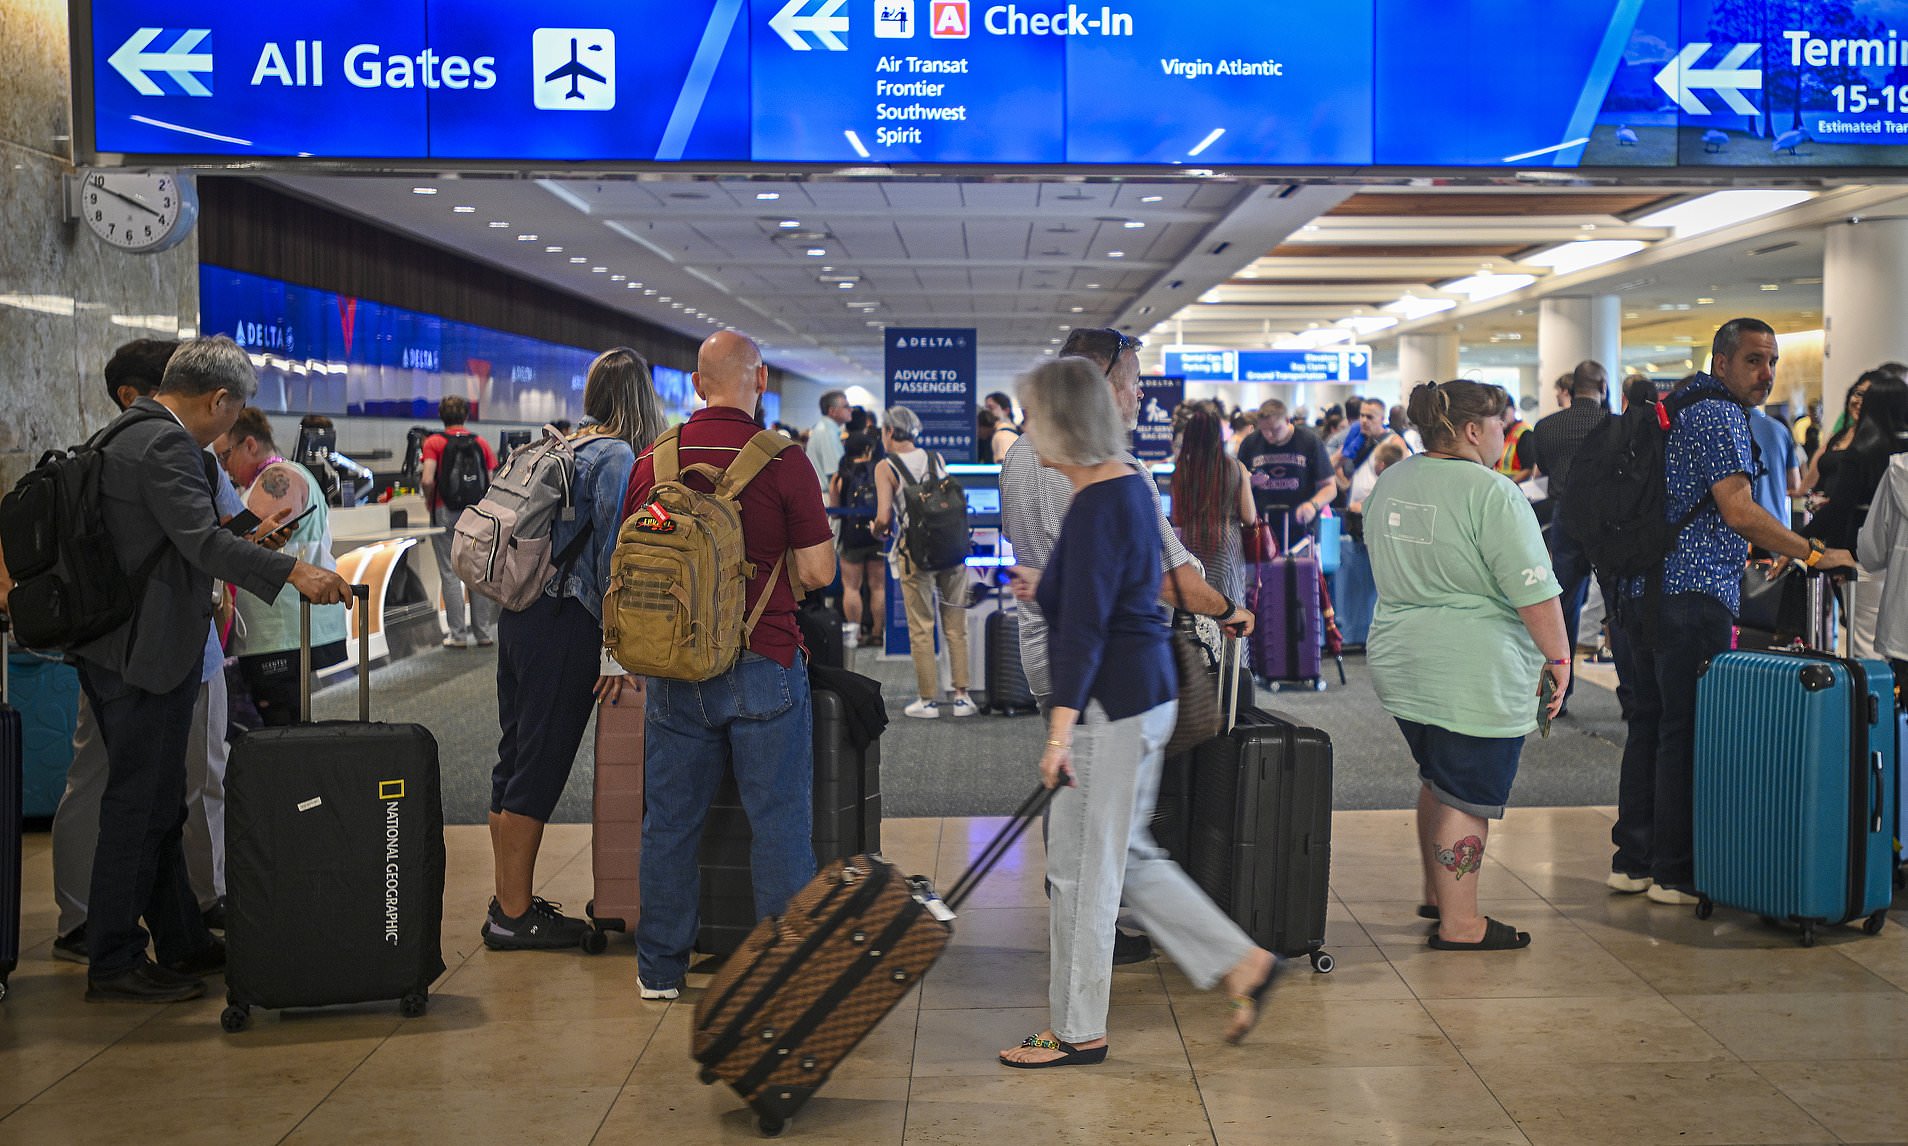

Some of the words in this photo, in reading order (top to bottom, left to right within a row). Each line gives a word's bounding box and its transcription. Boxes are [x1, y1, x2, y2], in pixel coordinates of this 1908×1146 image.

[984, 3, 1133, 36] Check-In
[250, 40, 323, 87] All
[343, 43, 497, 90] Gates
[876, 56, 902, 73] Air
[905, 56, 969, 74] Transat
[1160, 58, 1213, 80] Virgin
[1215, 58, 1283, 77] Atlantic
[876, 79, 945, 97] Frontier
[876, 102, 967, 121] Southwest
[1818, 119, 1881, 134] Estimated
[876, 126, 922, 147] Spirit
[158, 179, 166, 191] 2
[90, 193, 98, 205] 9
[163, 196, 171, 208] 3
[95, 210, 103, 222] 8
[108, 223, 116, 235] 7
[126, 229, 133, 241] 6
[144, 225, 152, 237] 5
[246, 321, 284, 349] DELTA
[910, 337, 953, 347] DELTA
[894, 370, 938, 381] ADVICE
[940, 370, 957, 381] TO
[894, 381, 967, 393] PASSENGERS
[385, 801, 399, 861] NATIONAL
[385, 863, 399, 942] GEOGRAPHIC
